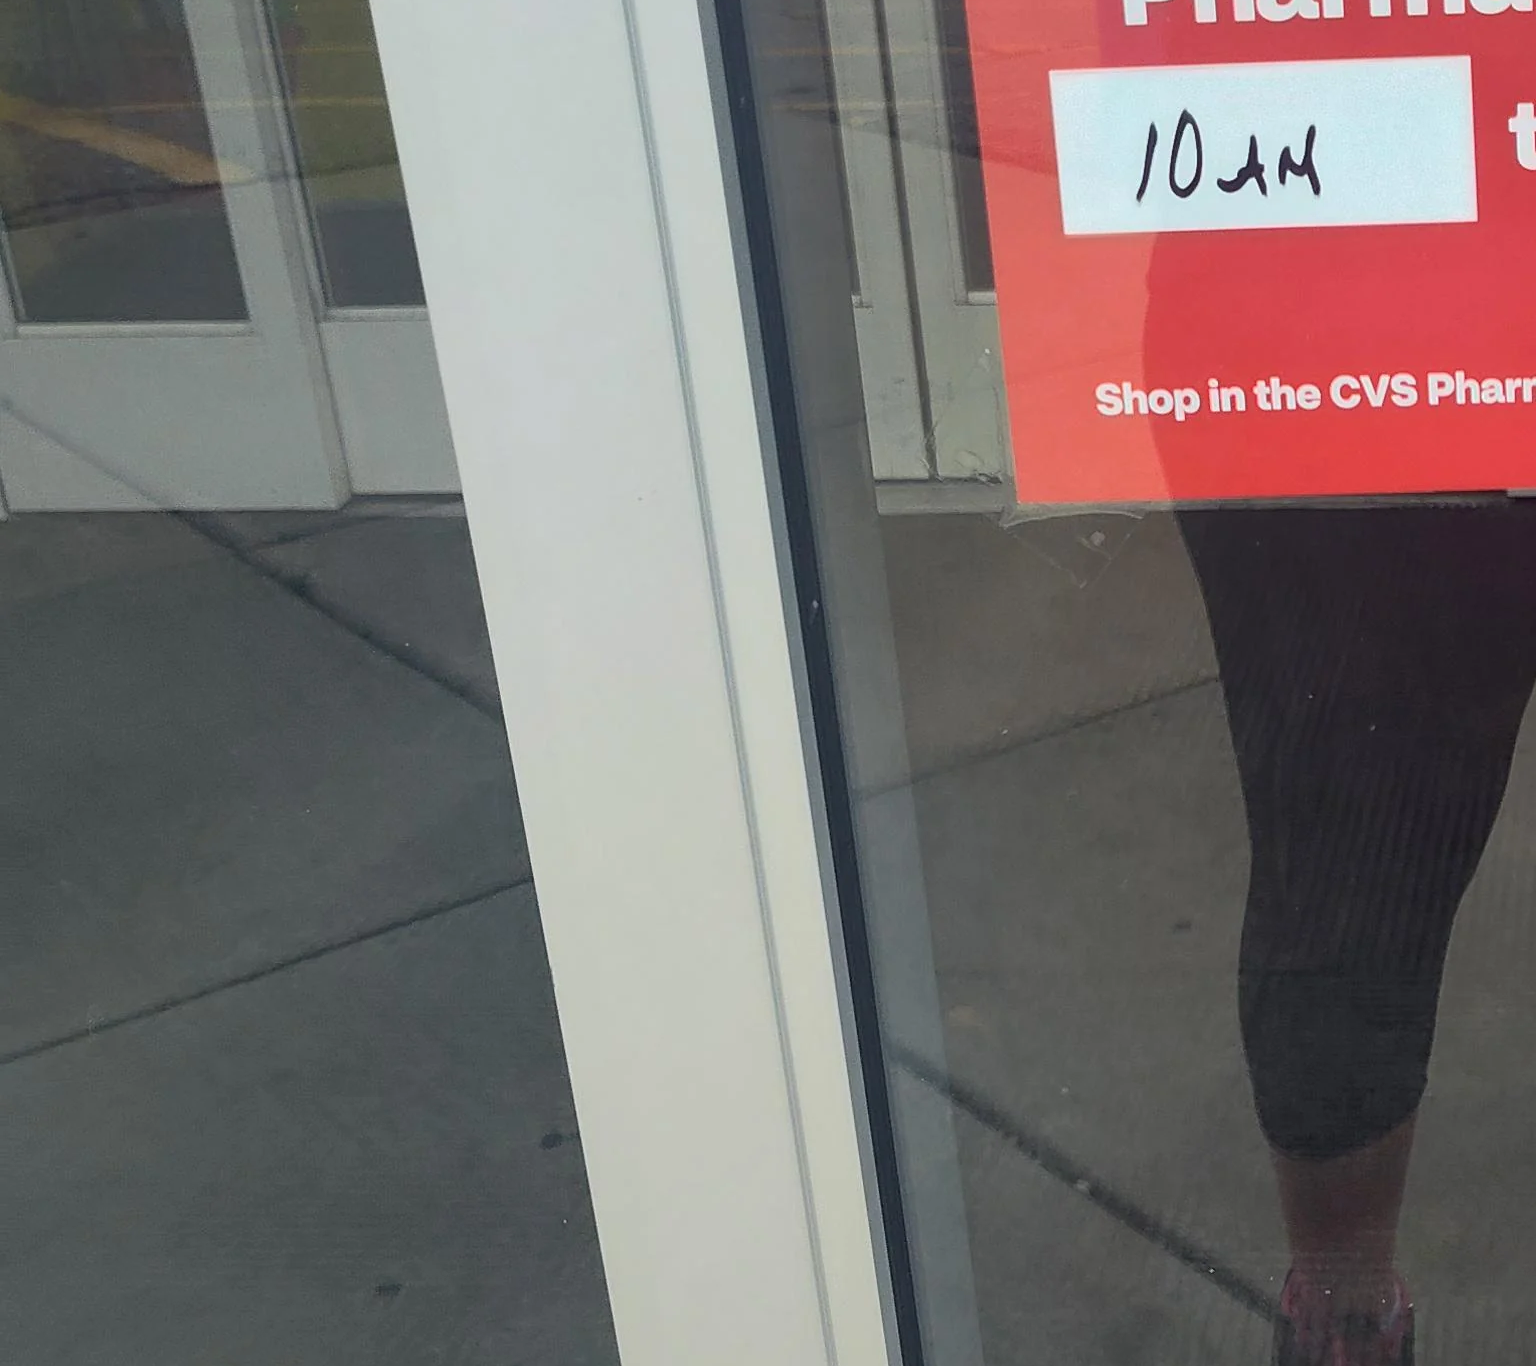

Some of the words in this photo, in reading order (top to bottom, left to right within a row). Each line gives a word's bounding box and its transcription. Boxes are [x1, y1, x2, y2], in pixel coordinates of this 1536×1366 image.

[1095, 381, 1201, 422] Shop
[1208, 379, 1246, 412] in
[1253, 376, 1322, 411] the
[1329, 373, 1418, 409] CVS
